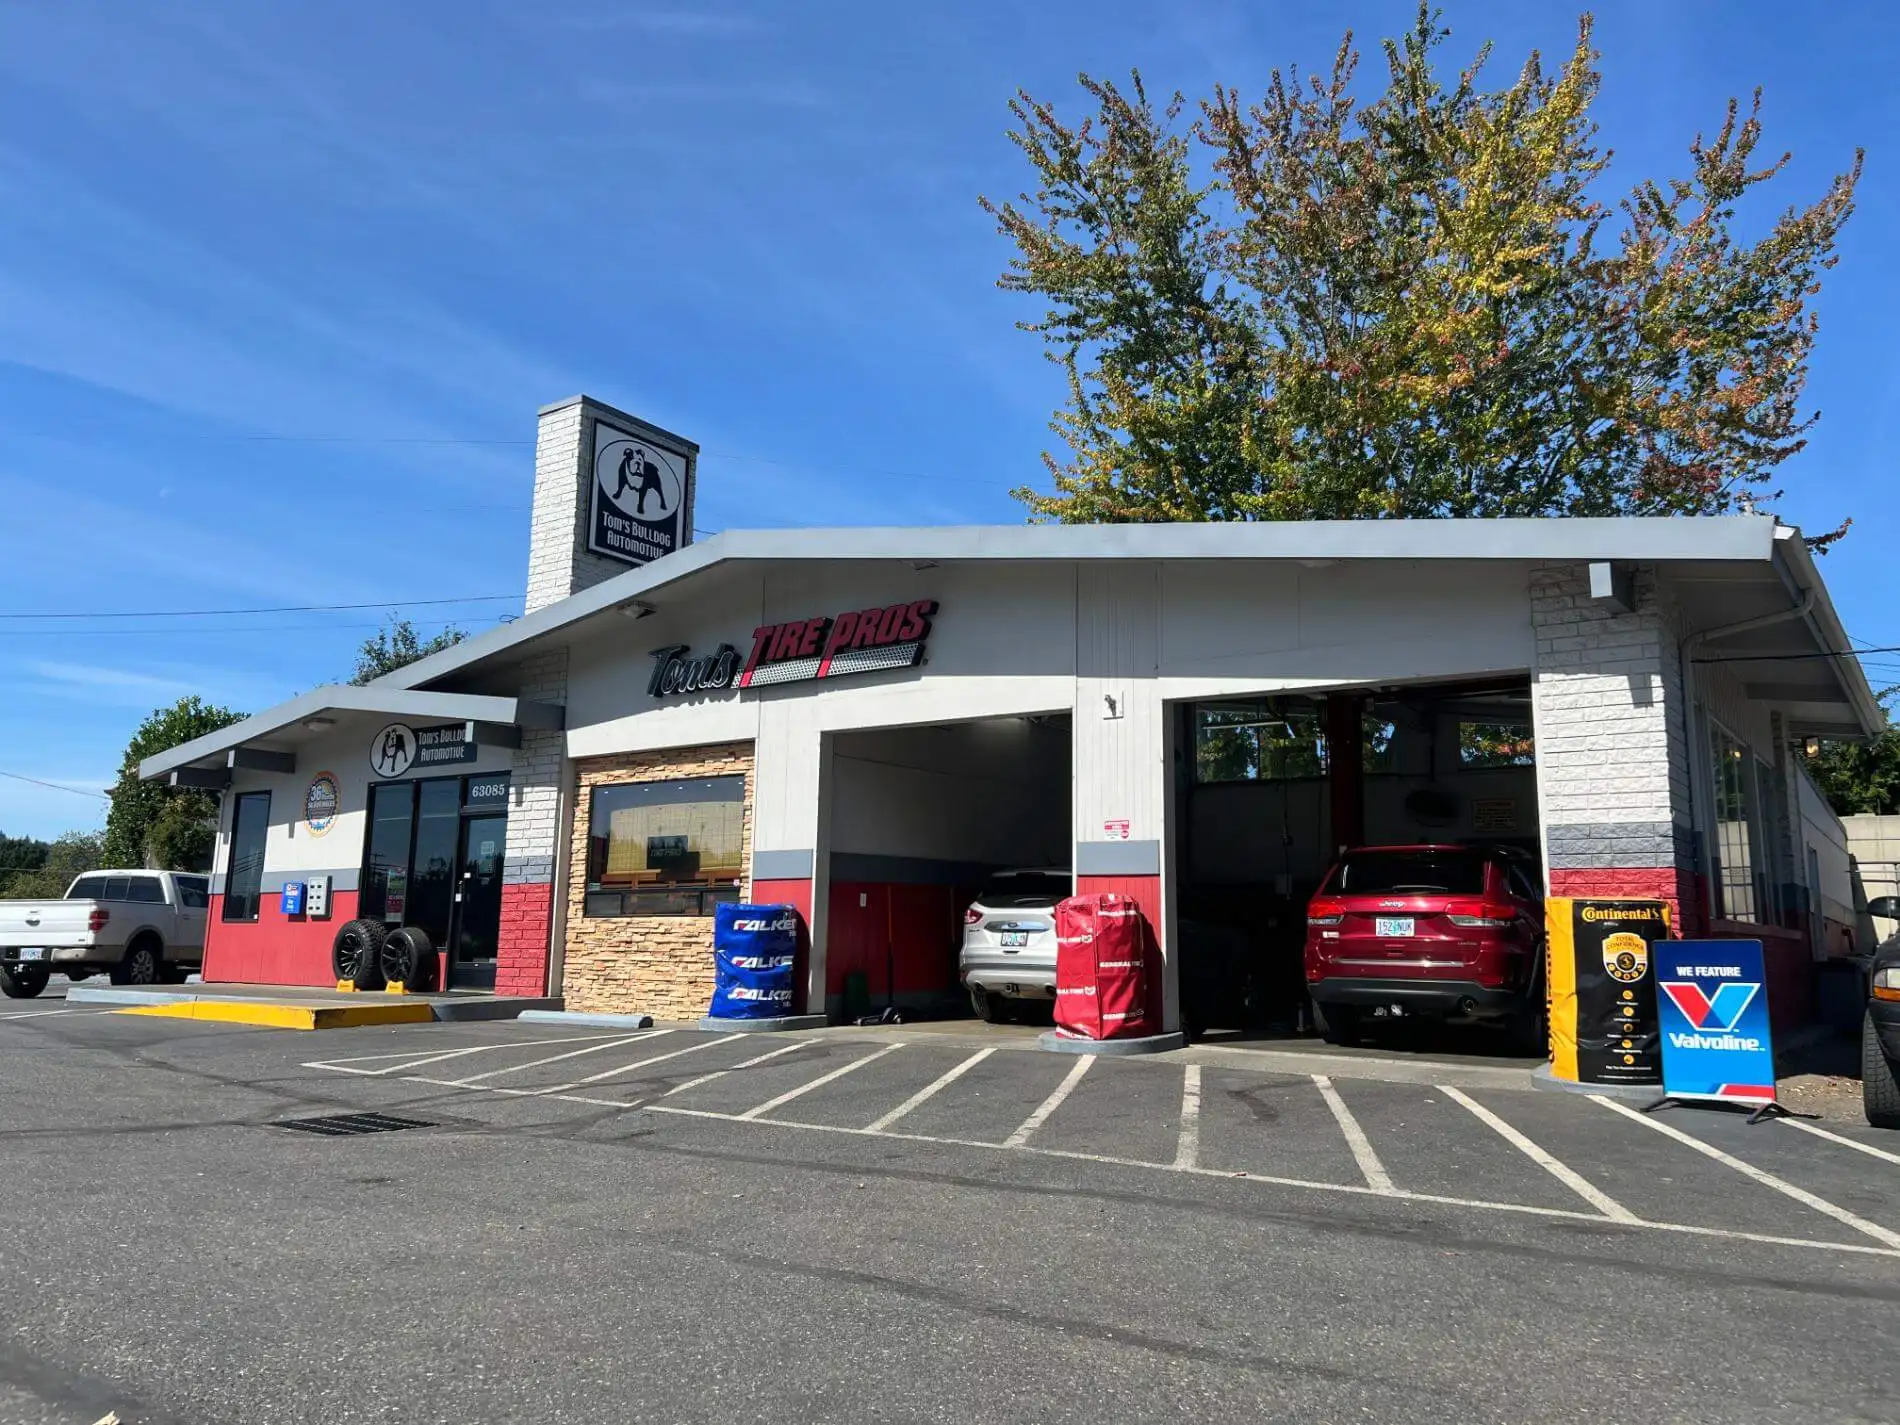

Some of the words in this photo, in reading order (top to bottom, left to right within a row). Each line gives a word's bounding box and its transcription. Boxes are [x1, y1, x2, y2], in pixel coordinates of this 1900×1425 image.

[602, 511, 631, 534] TOM'S
[631, 521, 671, 547] BULLDOG
[648, 643, 736, 697] Tom's
[739, 616, 833, 688] TIRE
[817, 600, 937, 679] PROS
[418, 731, 439, 745] TOM'S
[440, 729, 466, 743] BULLDO
[420, 746, 465, 761] AUTOMOTIVE
[472, 784, 505, 797] 63085
[1582, 907, 1651, 922] Continental
[1676, 967, 1694, 976] WE
[1695, 967, 1741, 977] FEATURE
[1668, 1032, 1759, 1051] Valvoline
